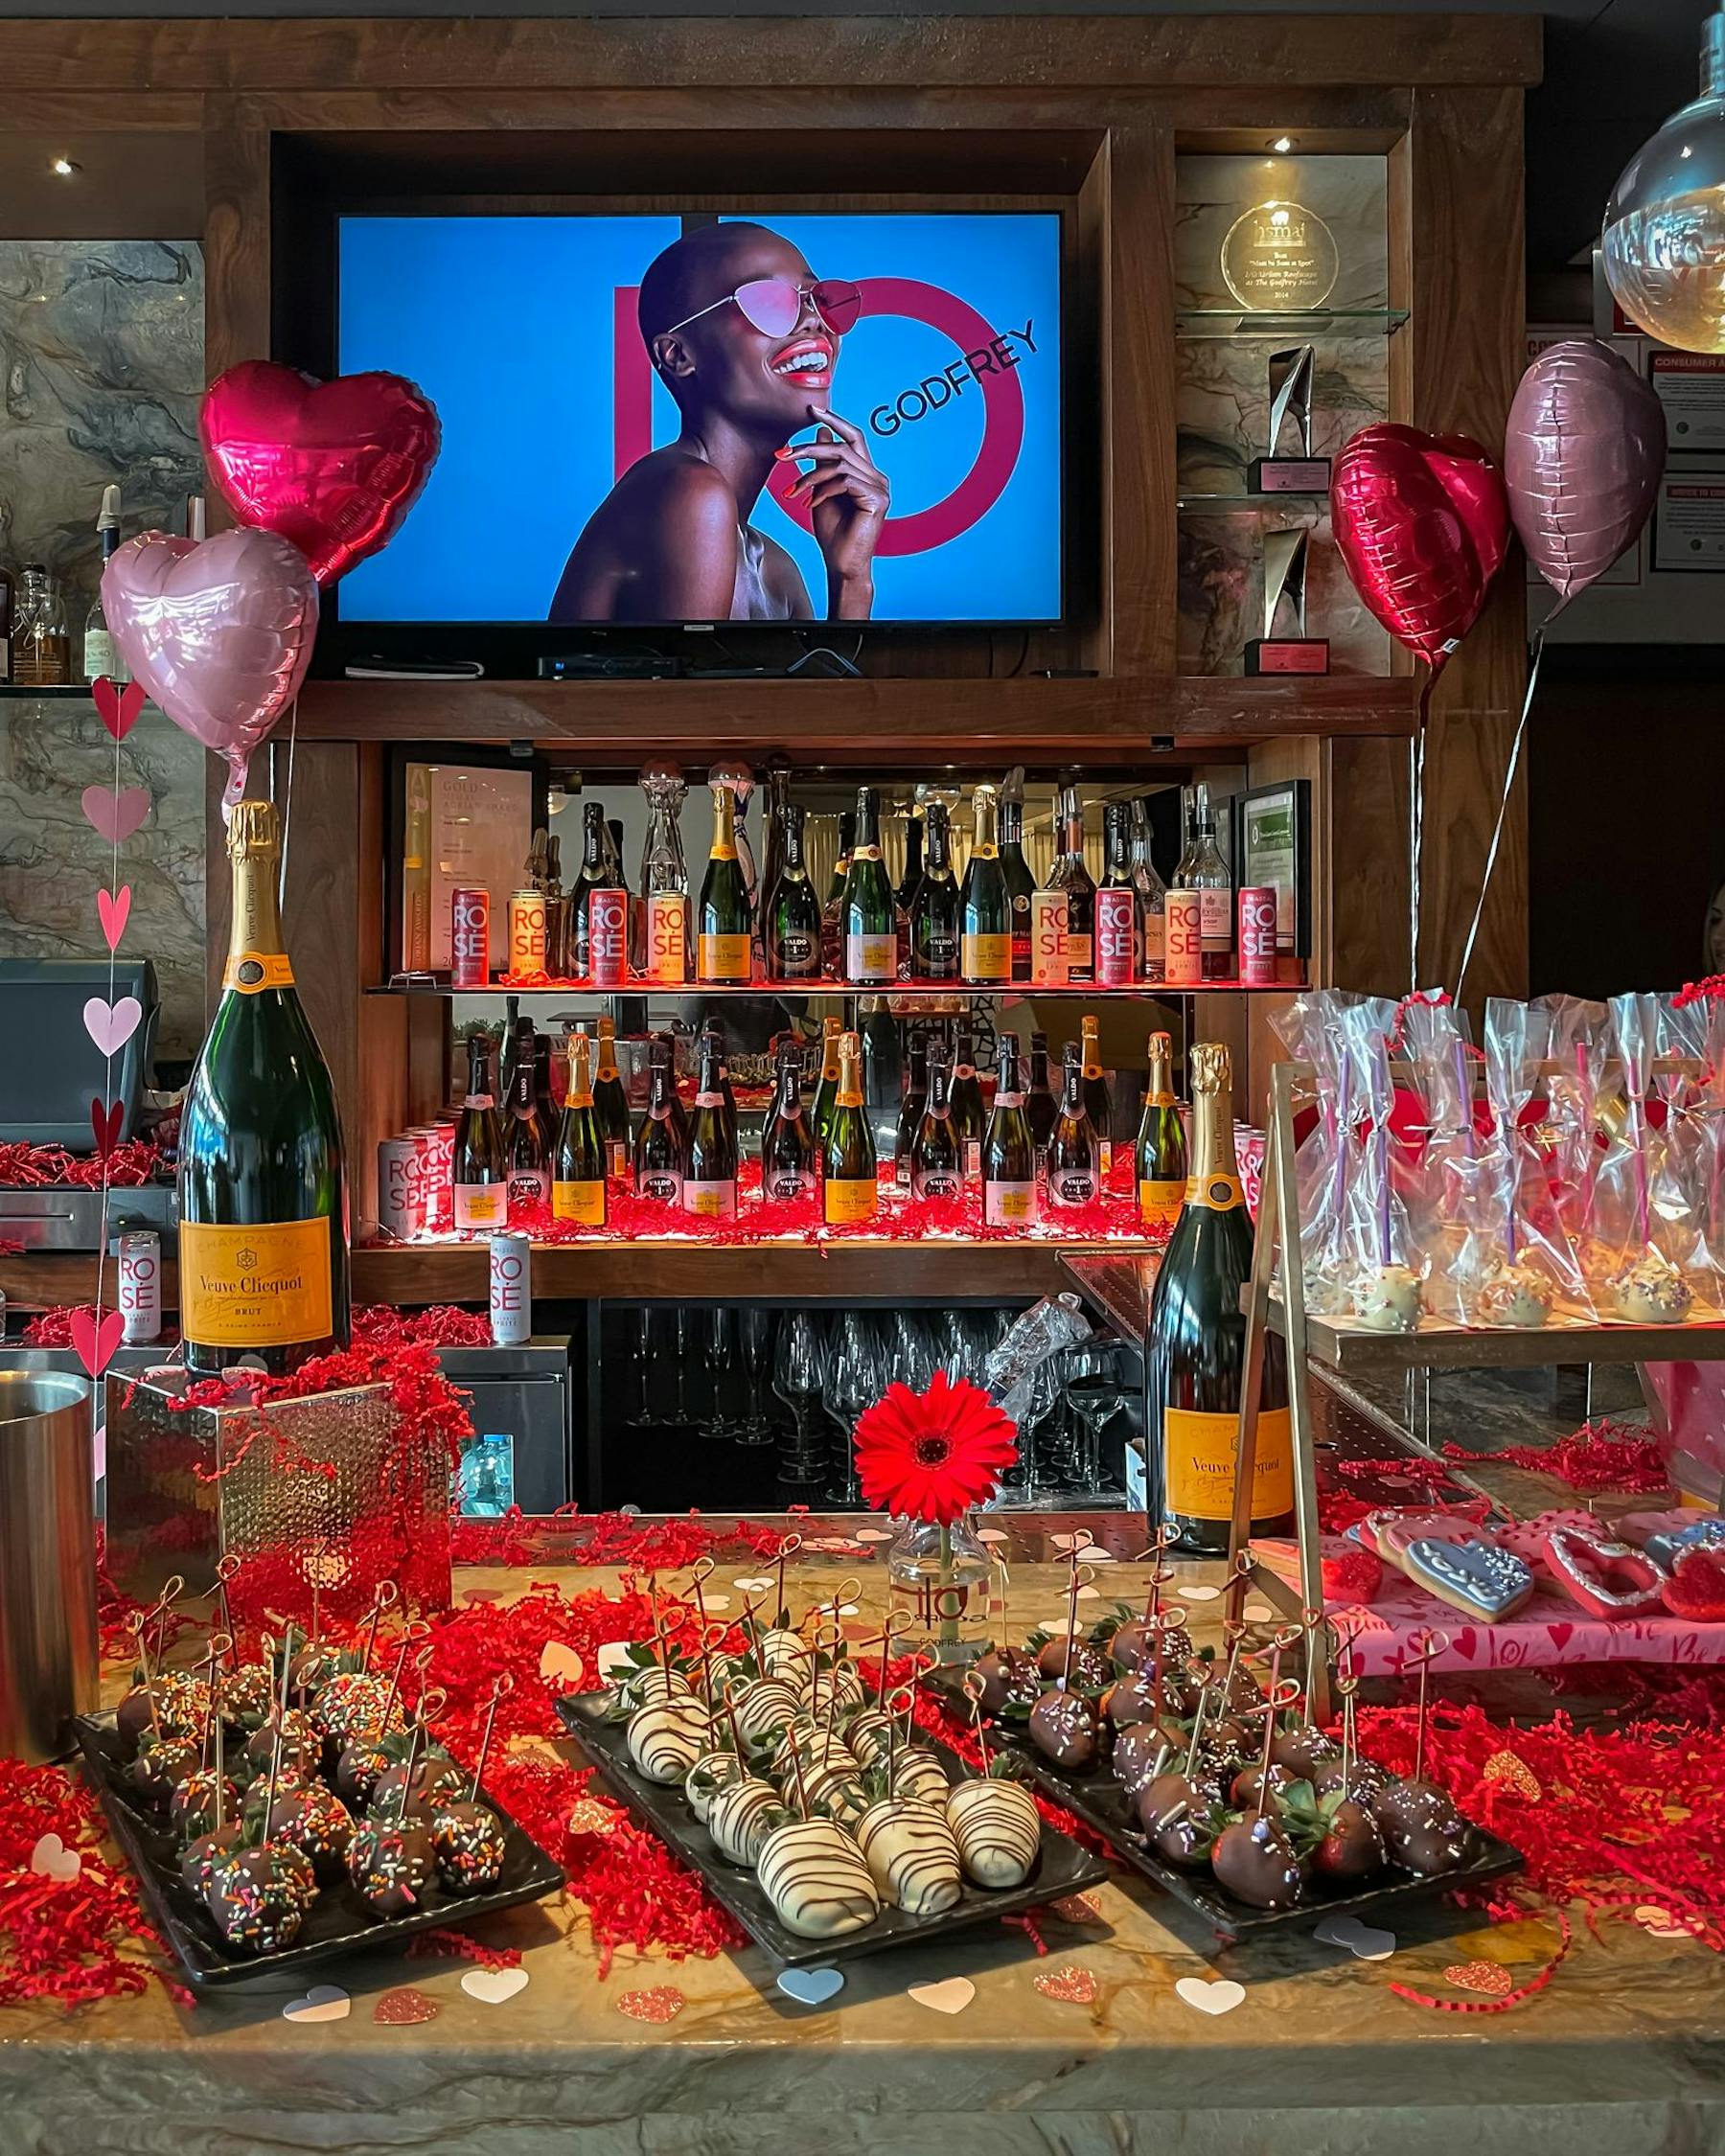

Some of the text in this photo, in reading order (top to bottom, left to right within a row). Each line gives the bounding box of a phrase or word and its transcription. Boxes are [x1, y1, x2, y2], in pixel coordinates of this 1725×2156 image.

[869, 318, 1038, 437] GODFREY
[454, 905, 487, 929] RO
[515, 908, 544, 929] RO
[591, 906, 624, 929] RO
[654, 908, 682, 929] RO
[1040, 906, 1069, 929] RO
[1099, 905, 1133, 929] RO
[1169, 906, 1201, 928] RO
[1242, 904, 1276, 929] RO
[198, 1235, 307, 1253] CHAMPAGNE
[121, 1257, 155, 1281] RO
[491, 1255, 522, 1281] RO
[200, 1275, 303, 1295] Veuve Clicquot
[235, 1307, 262, 1316] BRUT
[1191, 1456, 1230, 1474] Veuve
